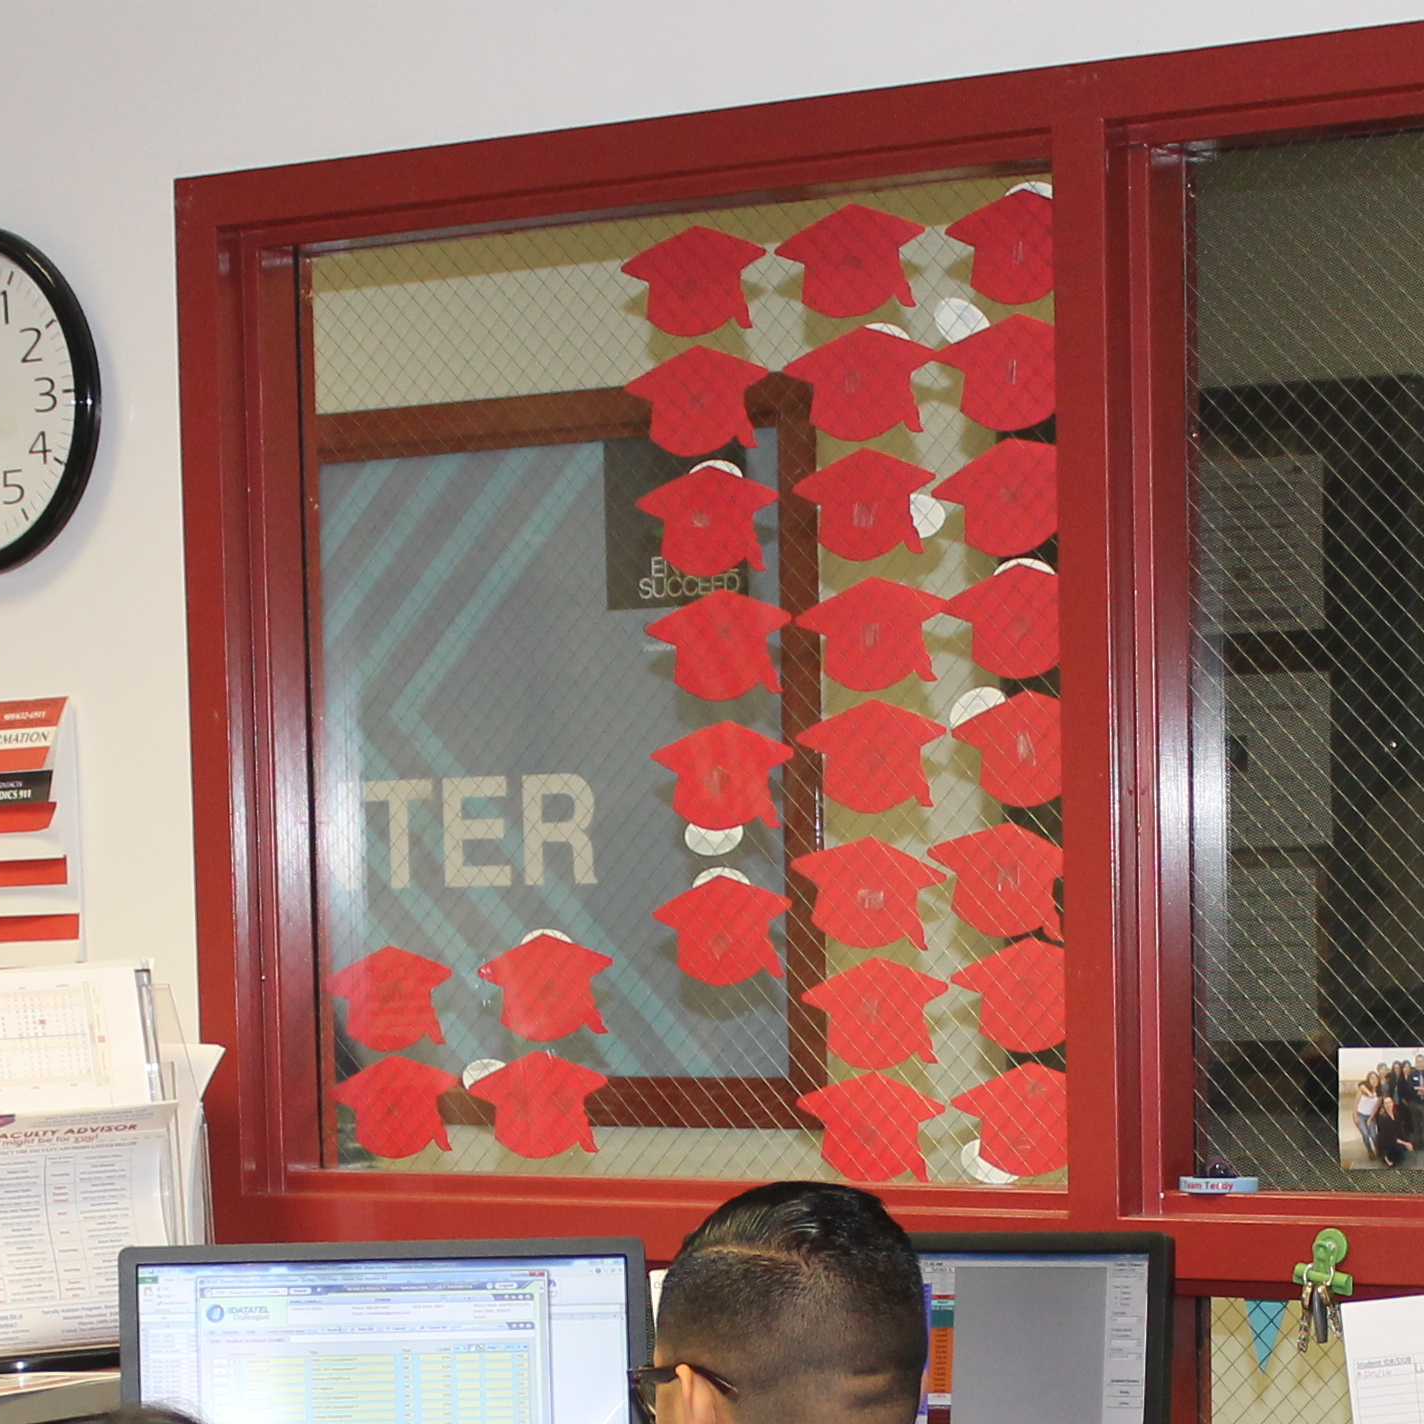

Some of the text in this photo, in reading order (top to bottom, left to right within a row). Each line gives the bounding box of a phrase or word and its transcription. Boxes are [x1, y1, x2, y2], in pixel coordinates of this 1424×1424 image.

[0, 290, 9, 325] 1
[19, 327, 43, 364] 2
[34, 377, 57, 412] 3
[29, 431, 52, 465] 4
[2, 469, 25, 505] 5
[639, 573, 740, 599] SUCCEED
[338, 773, 598, 889] TER
[2, 1137, 35, 1147] might
[63, 1123, 138, 1136] ADVISOR
[1182, 1181, 1234, 1193] Team Teddy
